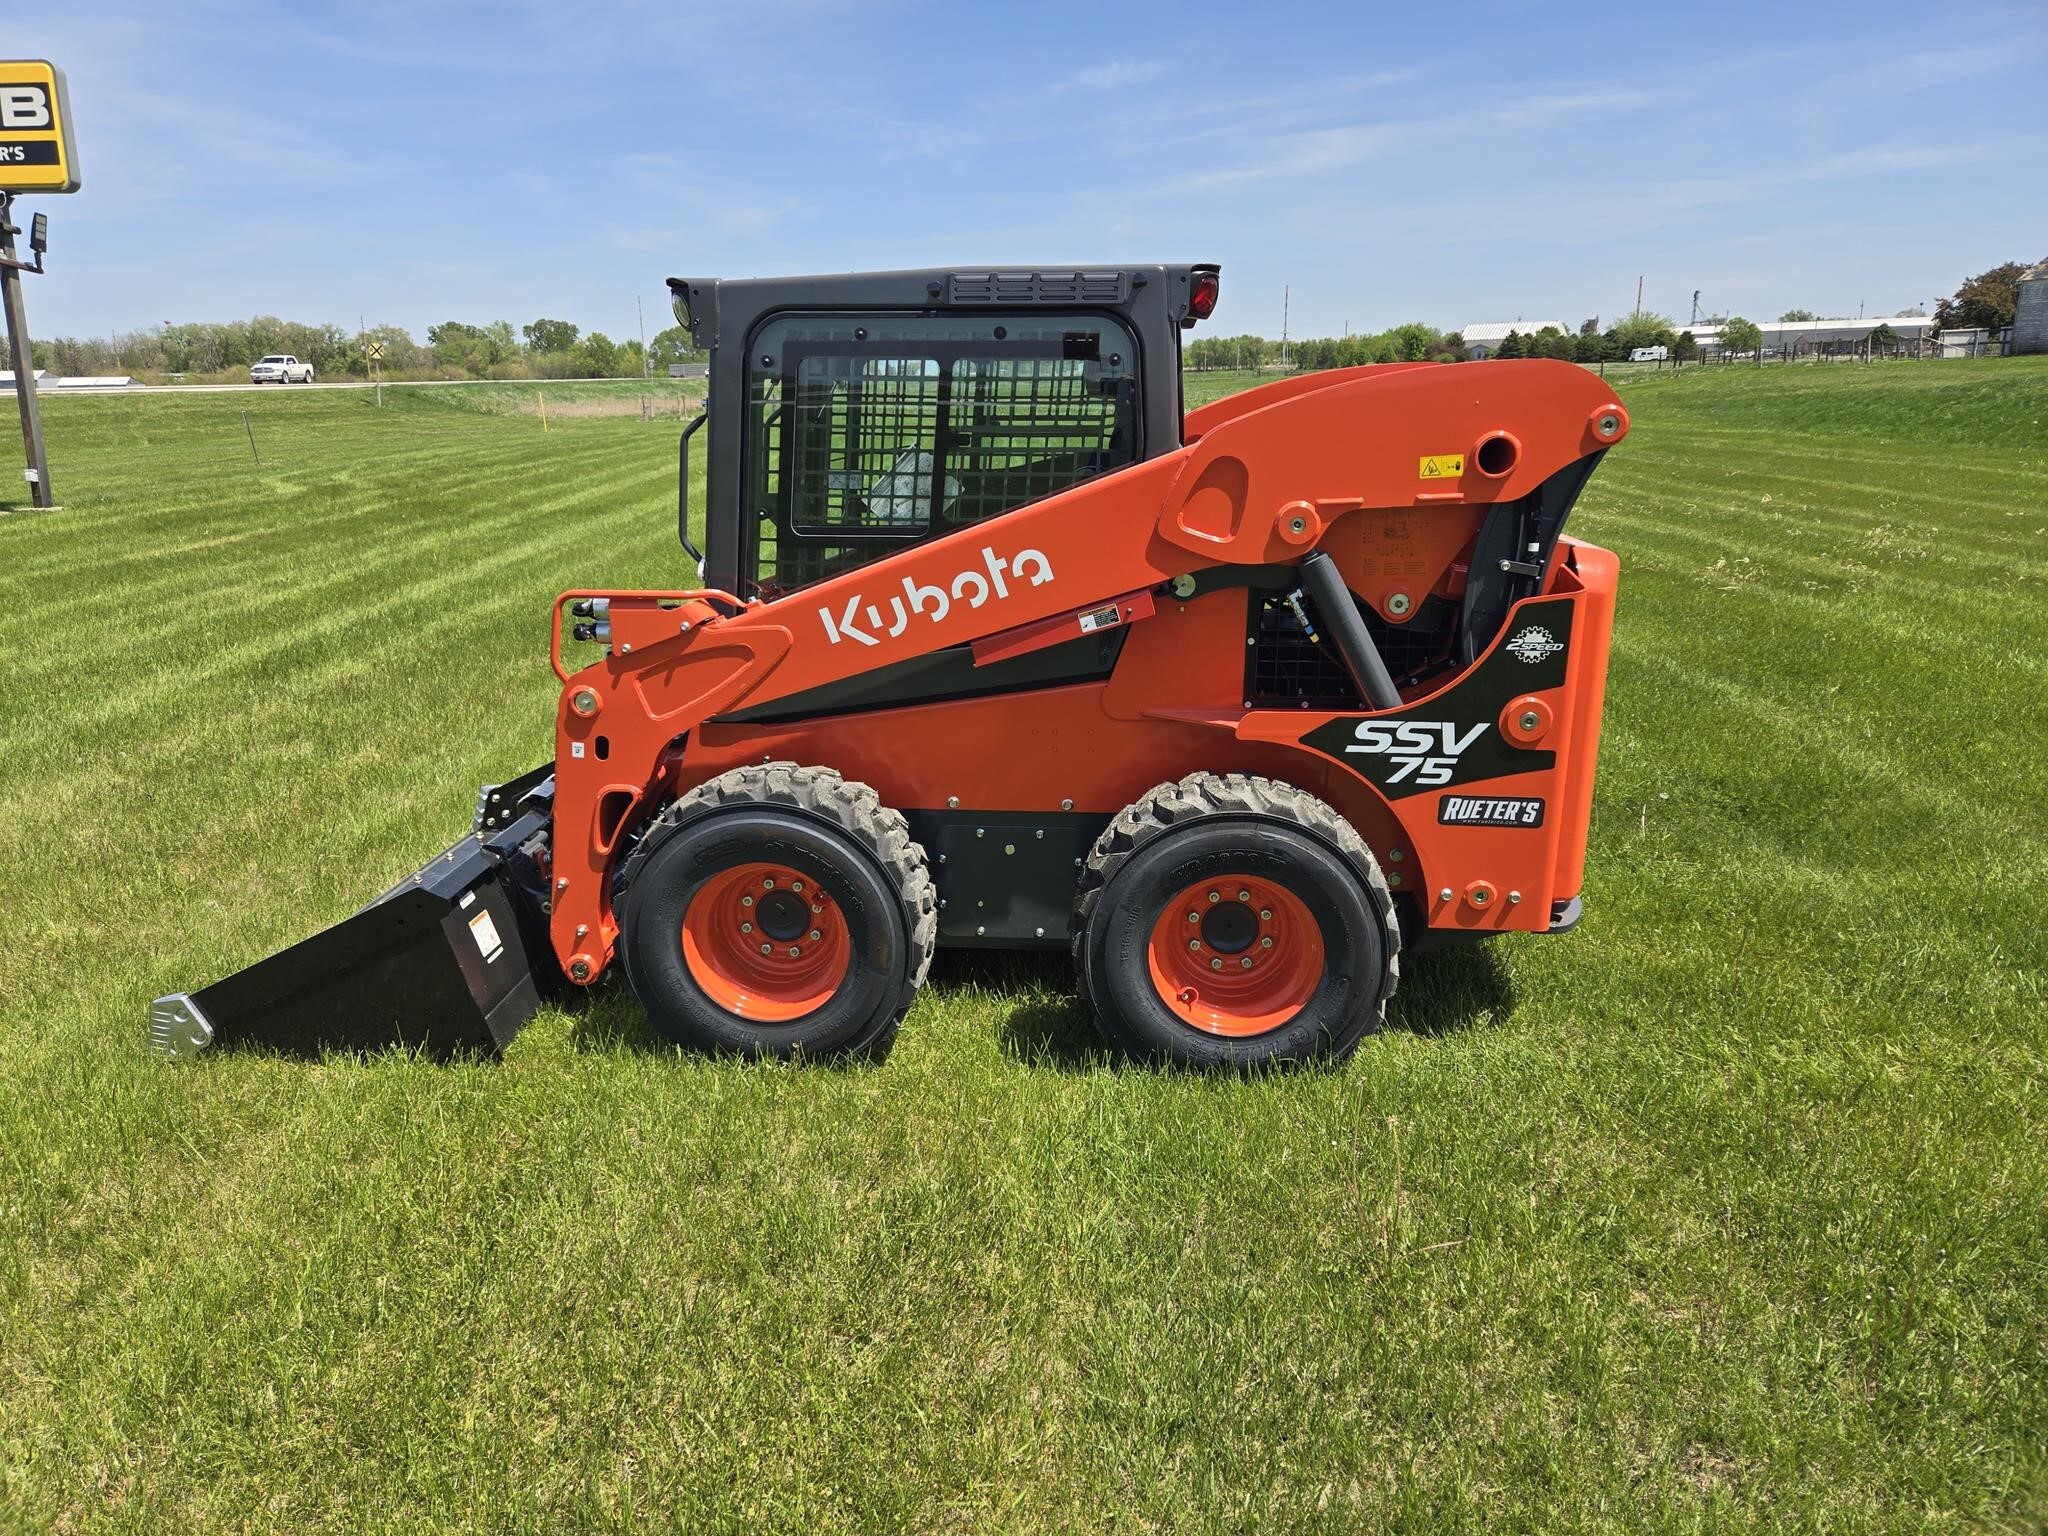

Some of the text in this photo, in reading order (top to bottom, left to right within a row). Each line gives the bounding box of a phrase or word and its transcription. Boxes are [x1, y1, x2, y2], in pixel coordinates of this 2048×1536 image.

[818, 546, 1055, 647] Kubota
[1344, 720, 1491, 756] SSV
[1385, 757, 1459, 785] 75
[1443, 798, 1540, 823] RUETER'S
